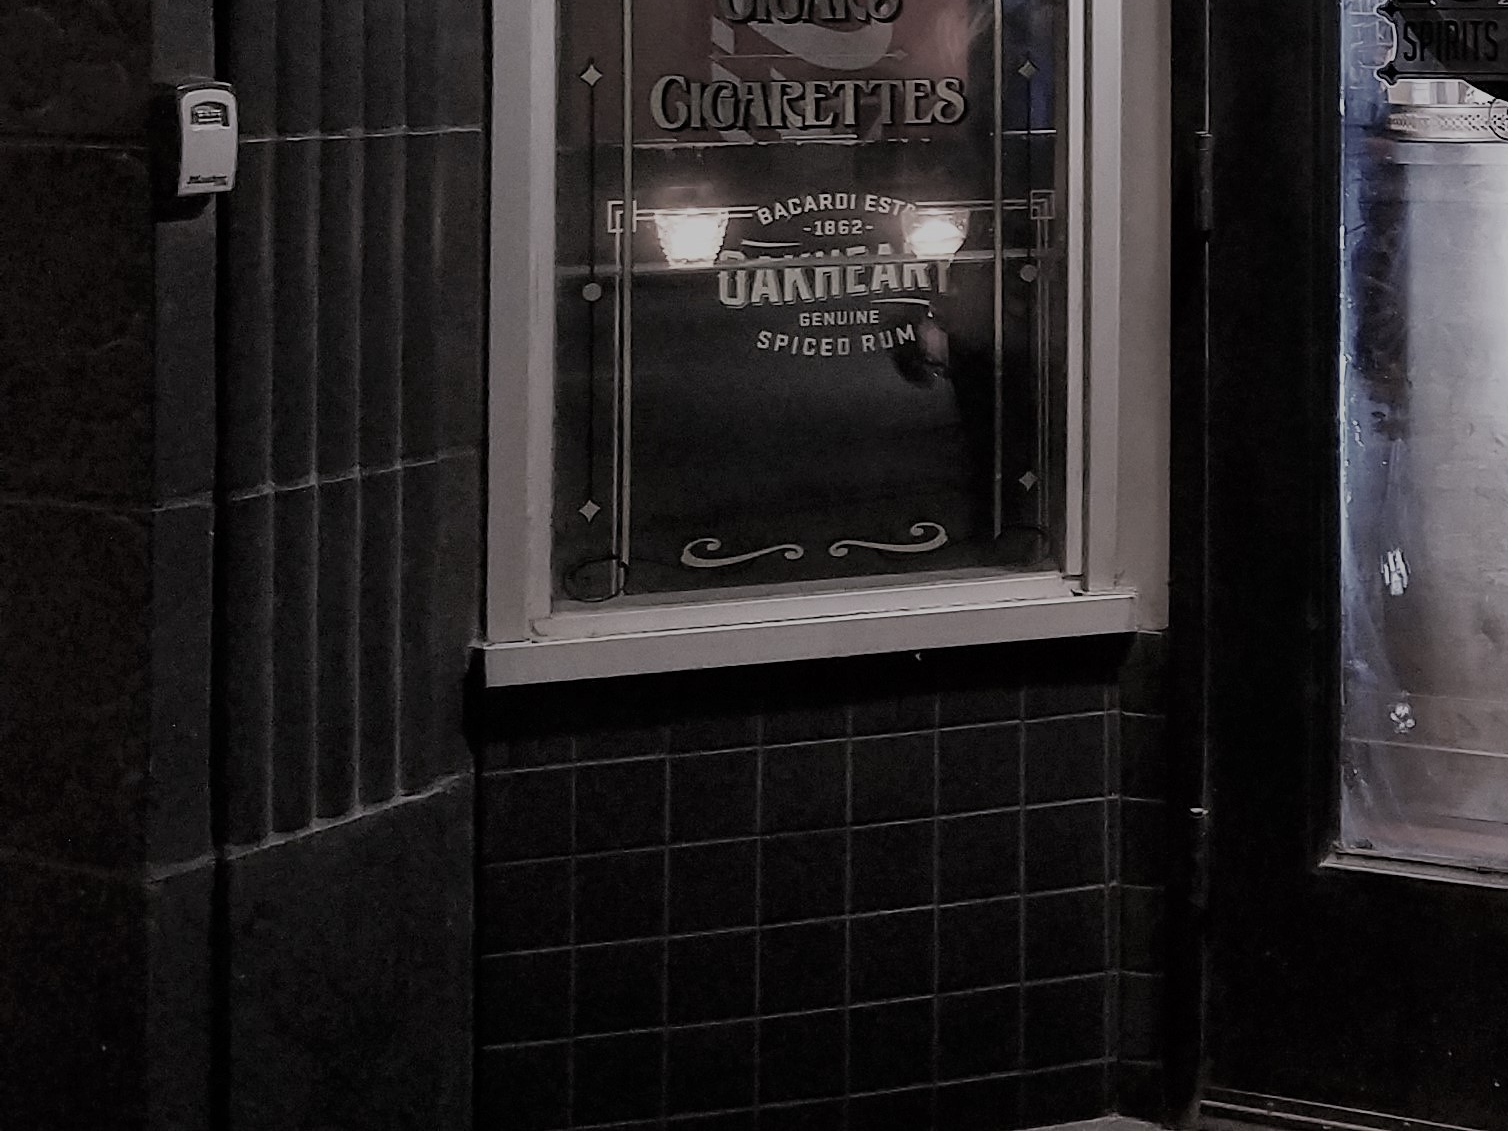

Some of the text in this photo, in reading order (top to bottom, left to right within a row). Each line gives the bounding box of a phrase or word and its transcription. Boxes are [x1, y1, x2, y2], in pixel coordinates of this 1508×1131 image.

[1402, 19, 1499, 63] SPIRITS
[648, 73, 969, 133] CIGARETTES
[756, 192, 857, 227] BACARDI
[799, 309, 880, 328] GENUINE
[756, 323, 917, 357] SPICED RUM
